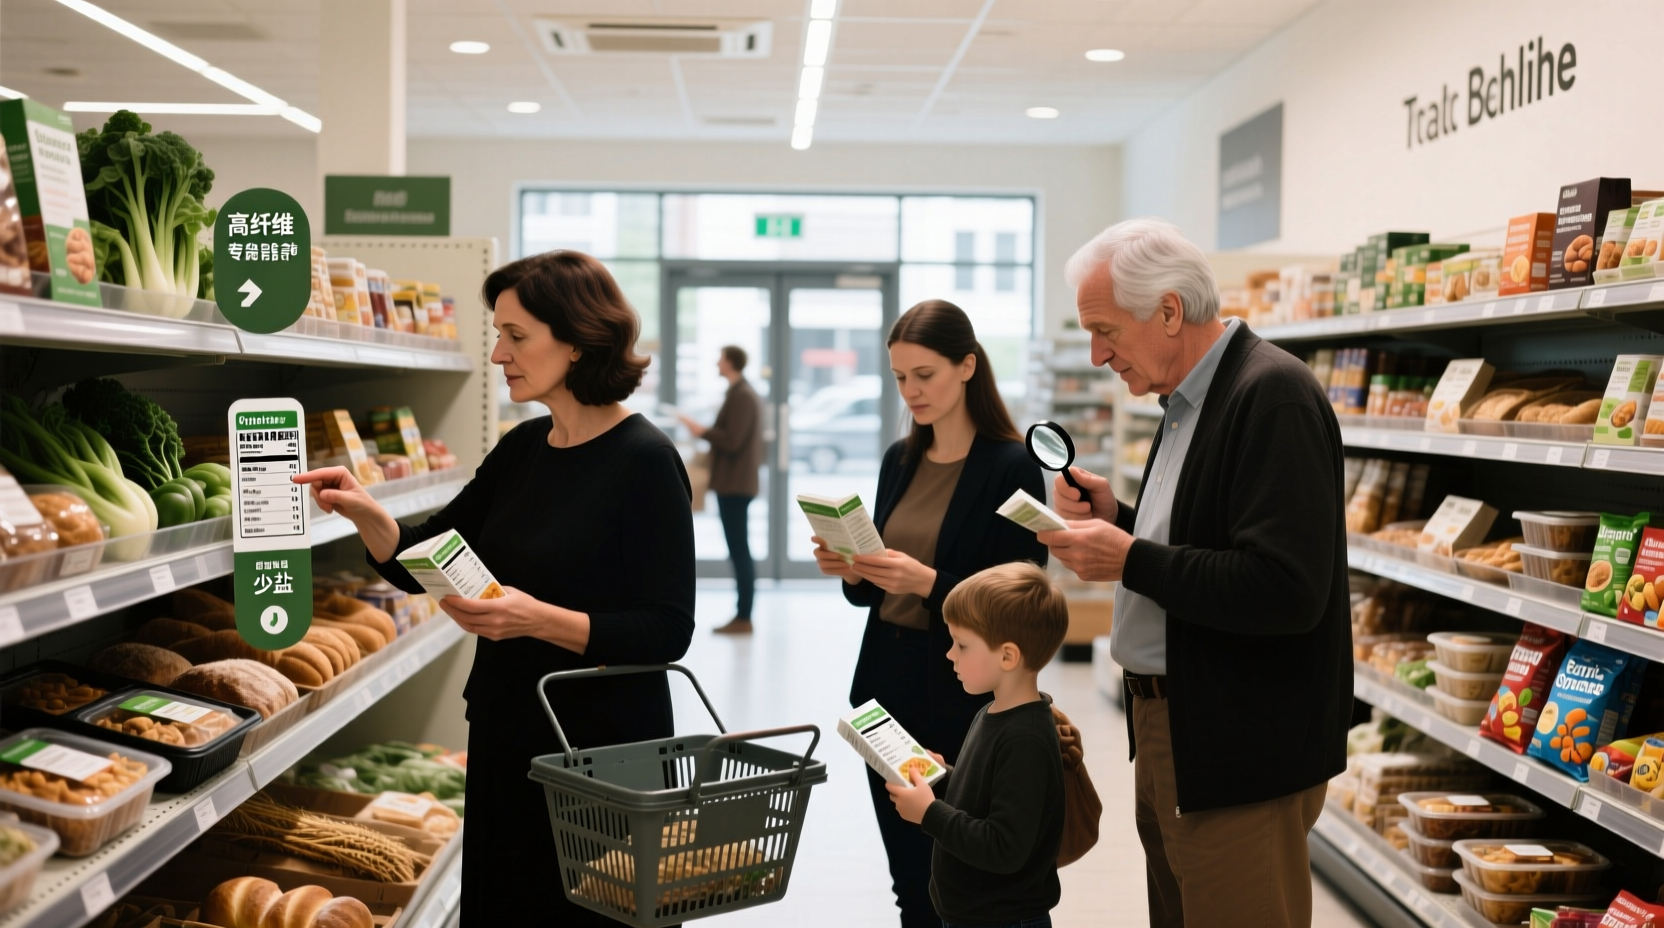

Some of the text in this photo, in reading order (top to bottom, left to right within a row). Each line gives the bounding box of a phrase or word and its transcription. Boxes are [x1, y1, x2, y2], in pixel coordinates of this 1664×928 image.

[227, 212, 294, 237] 高纤维
[253, 571, 294, 595] 少盐
